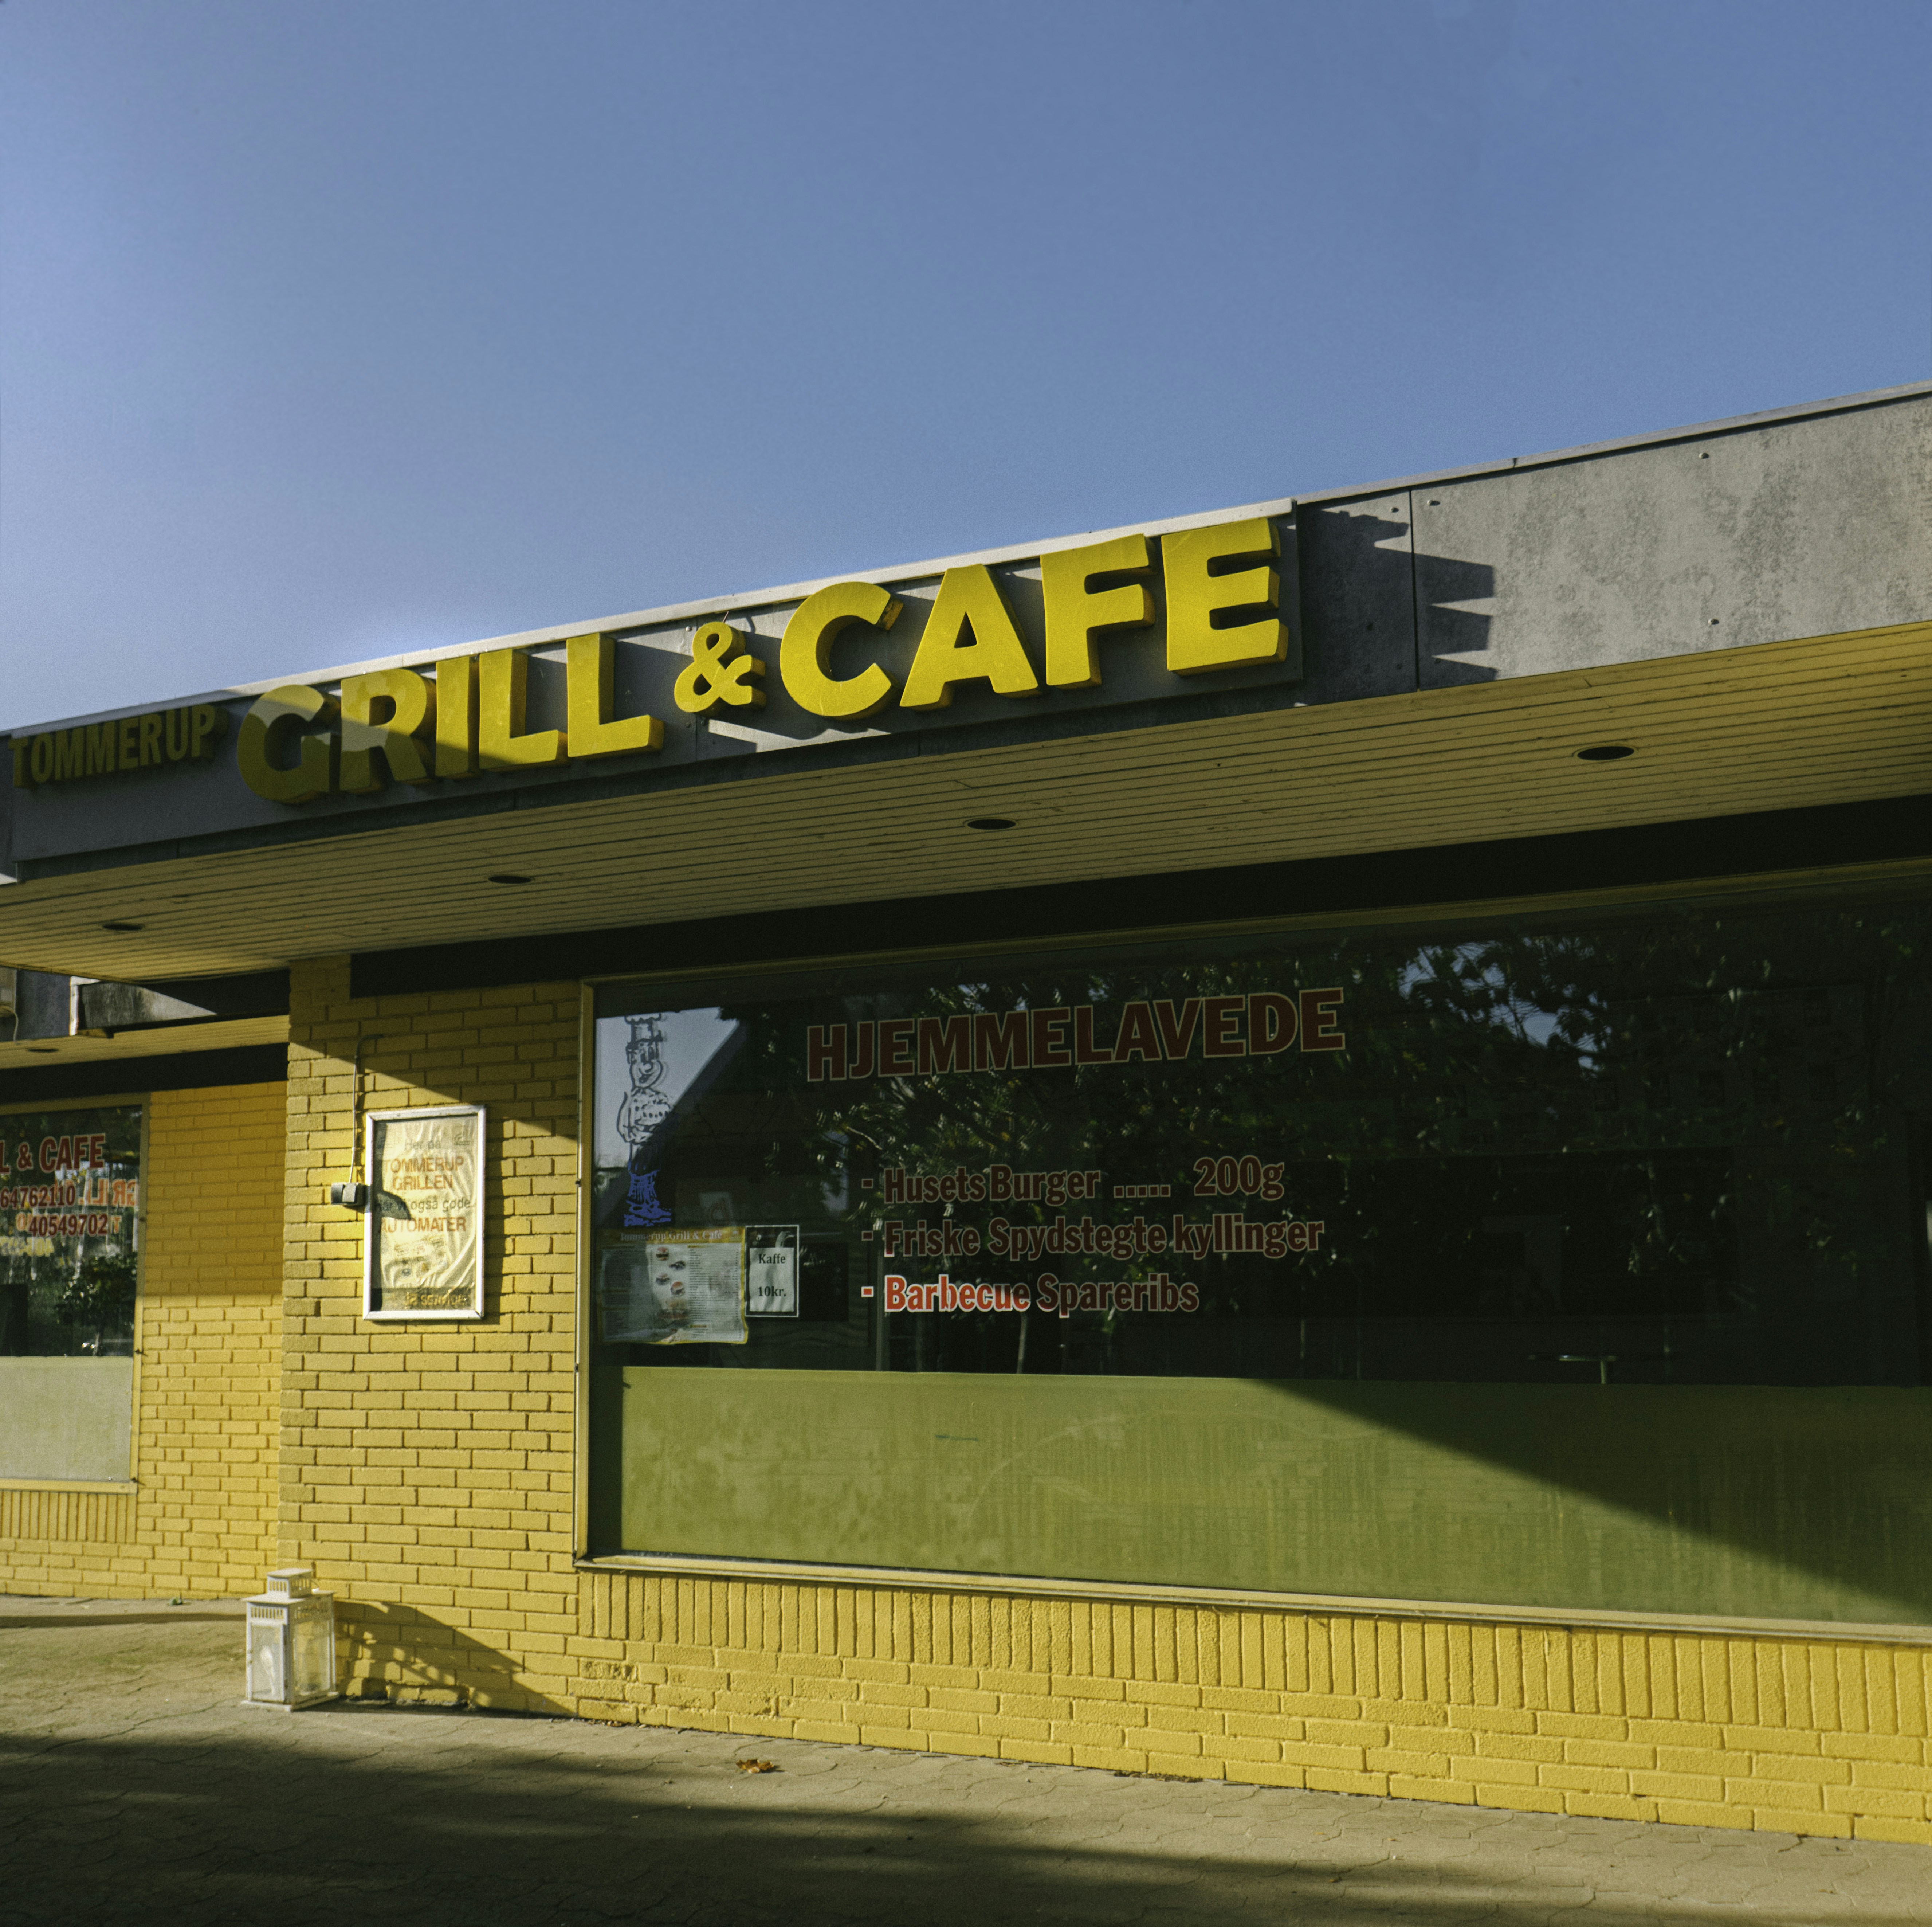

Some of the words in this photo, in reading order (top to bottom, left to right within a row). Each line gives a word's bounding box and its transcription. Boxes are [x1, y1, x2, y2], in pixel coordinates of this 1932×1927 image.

[8, 704, 216, 788] TOMMERUP
[237, 632, 661, 804] GRILL
[674, 622, 759, 713] &
[780, 518, 1284, 718] CAFE
[806, 987, 1346, 1082] HJEMMELAVEDE
[39, 1132, 106, 1174] CAFE
[385, 1155, 464, 1173] TOMMERUP
[393, 1174, 453, 1190] GRILLEN
[1193, 1155, 1284, 1201] 200g
[0, 1184, 76, 1211] 64762110
[28, 1212, 108, 1238] 40549702
[380, 1216, 466, 1233] AUTOMATER
[669, 1230, 690, 1240] Grill
[884, 1219, 981, 1257] Friske
[987, 1216, 1167, 1261] Spydstegte
[1173, 1213, 1324, 1260] kyllinger
[758, 1253, 786, 1264] Kaffe
[758, 1286, 786, 1297] 10kr.
[884, 1274, 1031, 1312] Barbecue
[1037, 1273, 1200, 1319] Spareribs
